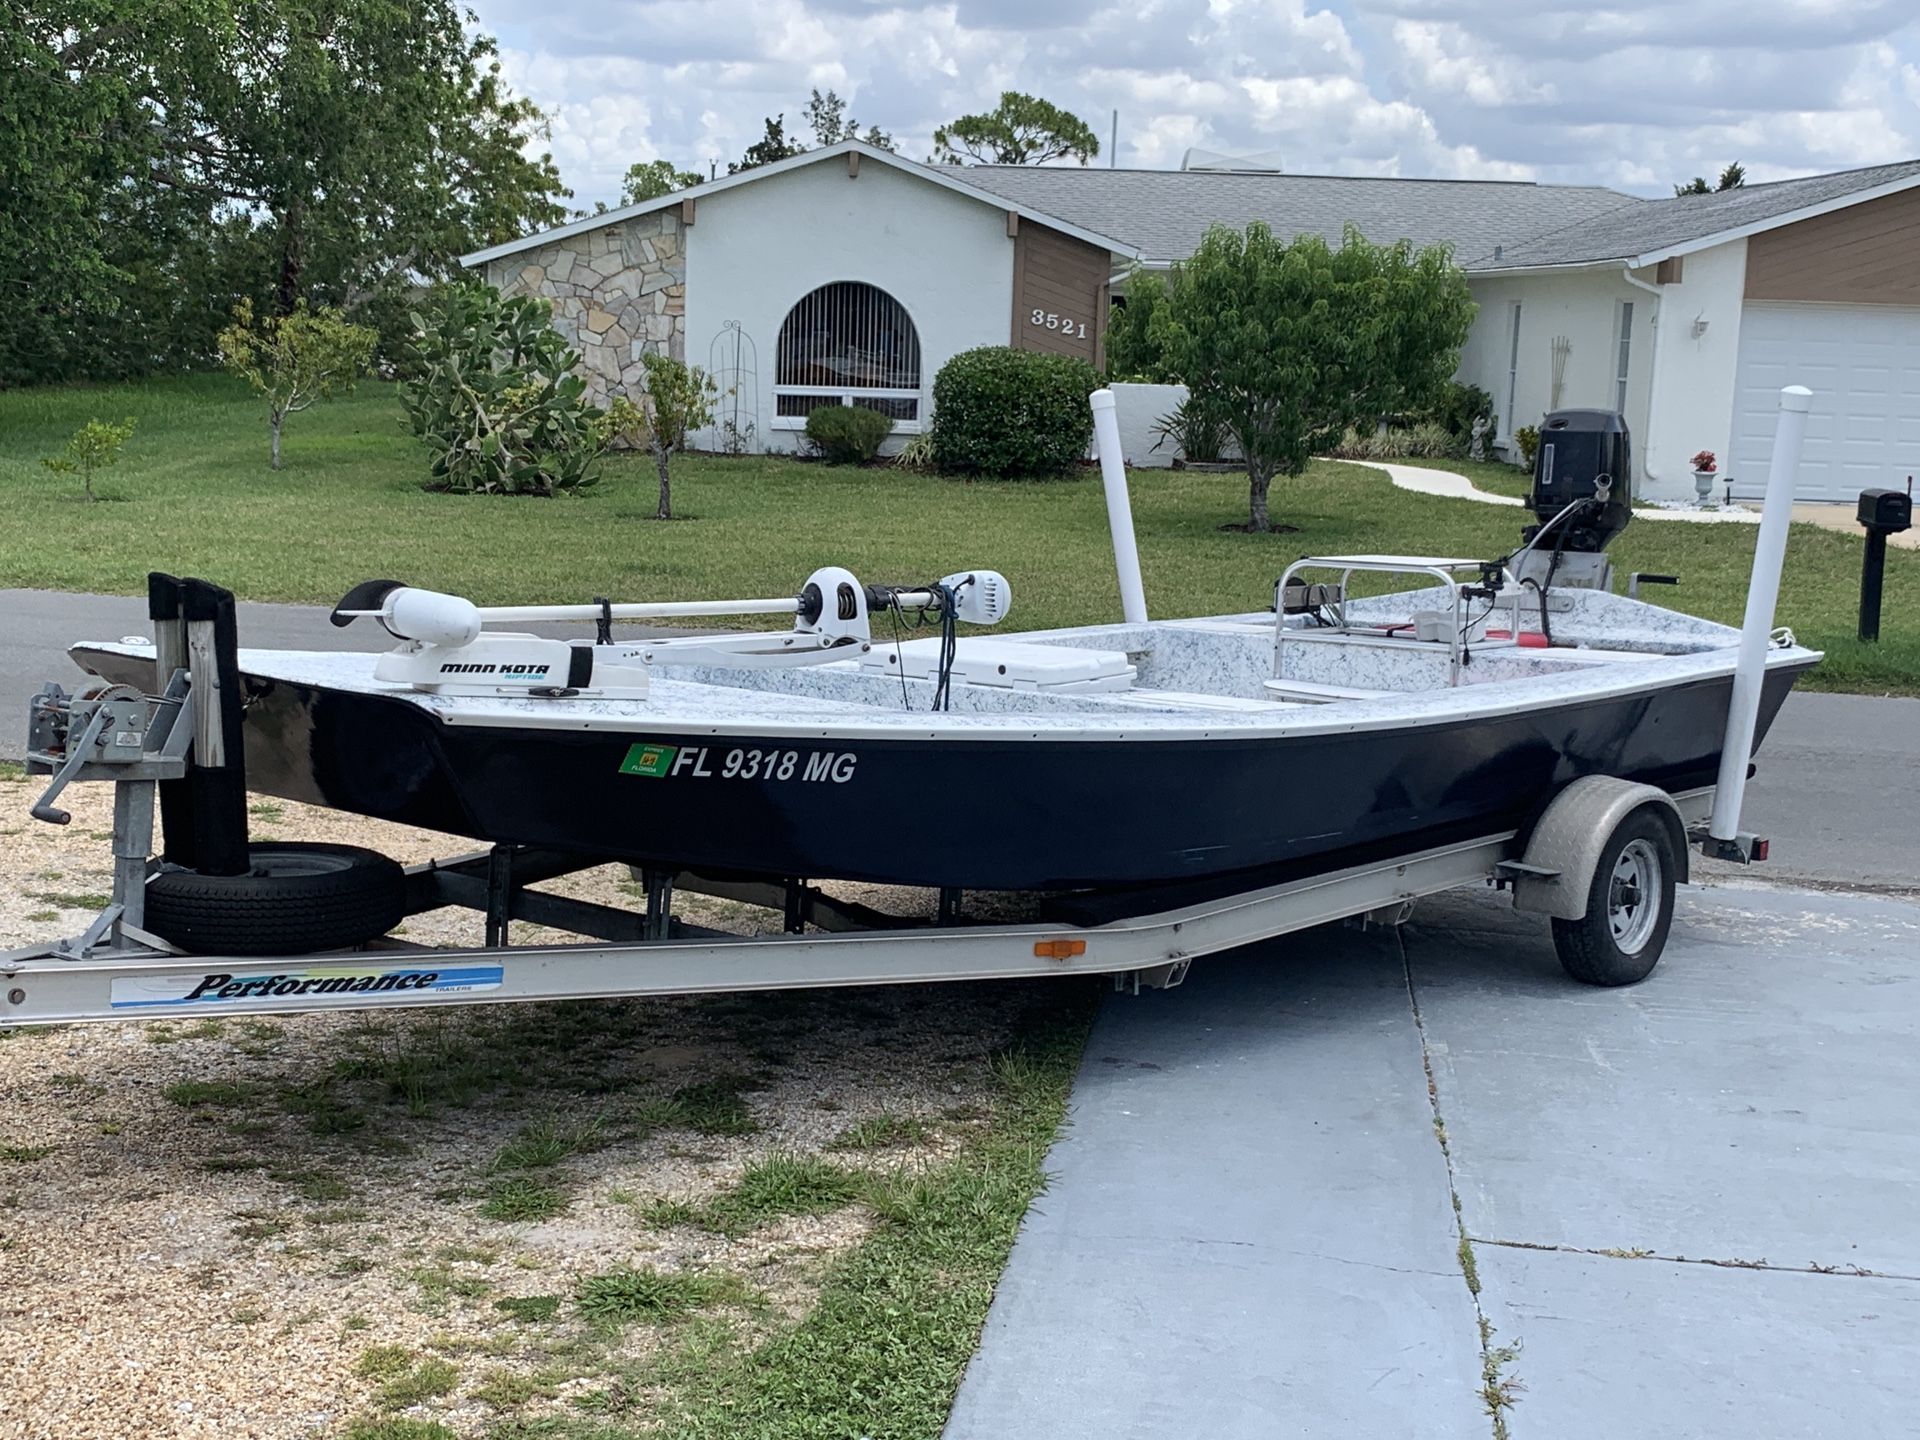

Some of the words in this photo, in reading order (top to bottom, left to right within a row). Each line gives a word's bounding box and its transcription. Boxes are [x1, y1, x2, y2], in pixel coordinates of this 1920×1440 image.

[1031, 309, 1086, 338] 3521
[499, 664, 550, 674] KOTA
[631, 764, 657, 773] FLORIDA
[671, 747, 712, 777] FL
[722, 748, 798, 780] 9318
[802, 751, 857, 783] MG
[184, 973, 438, 1000] Performance
